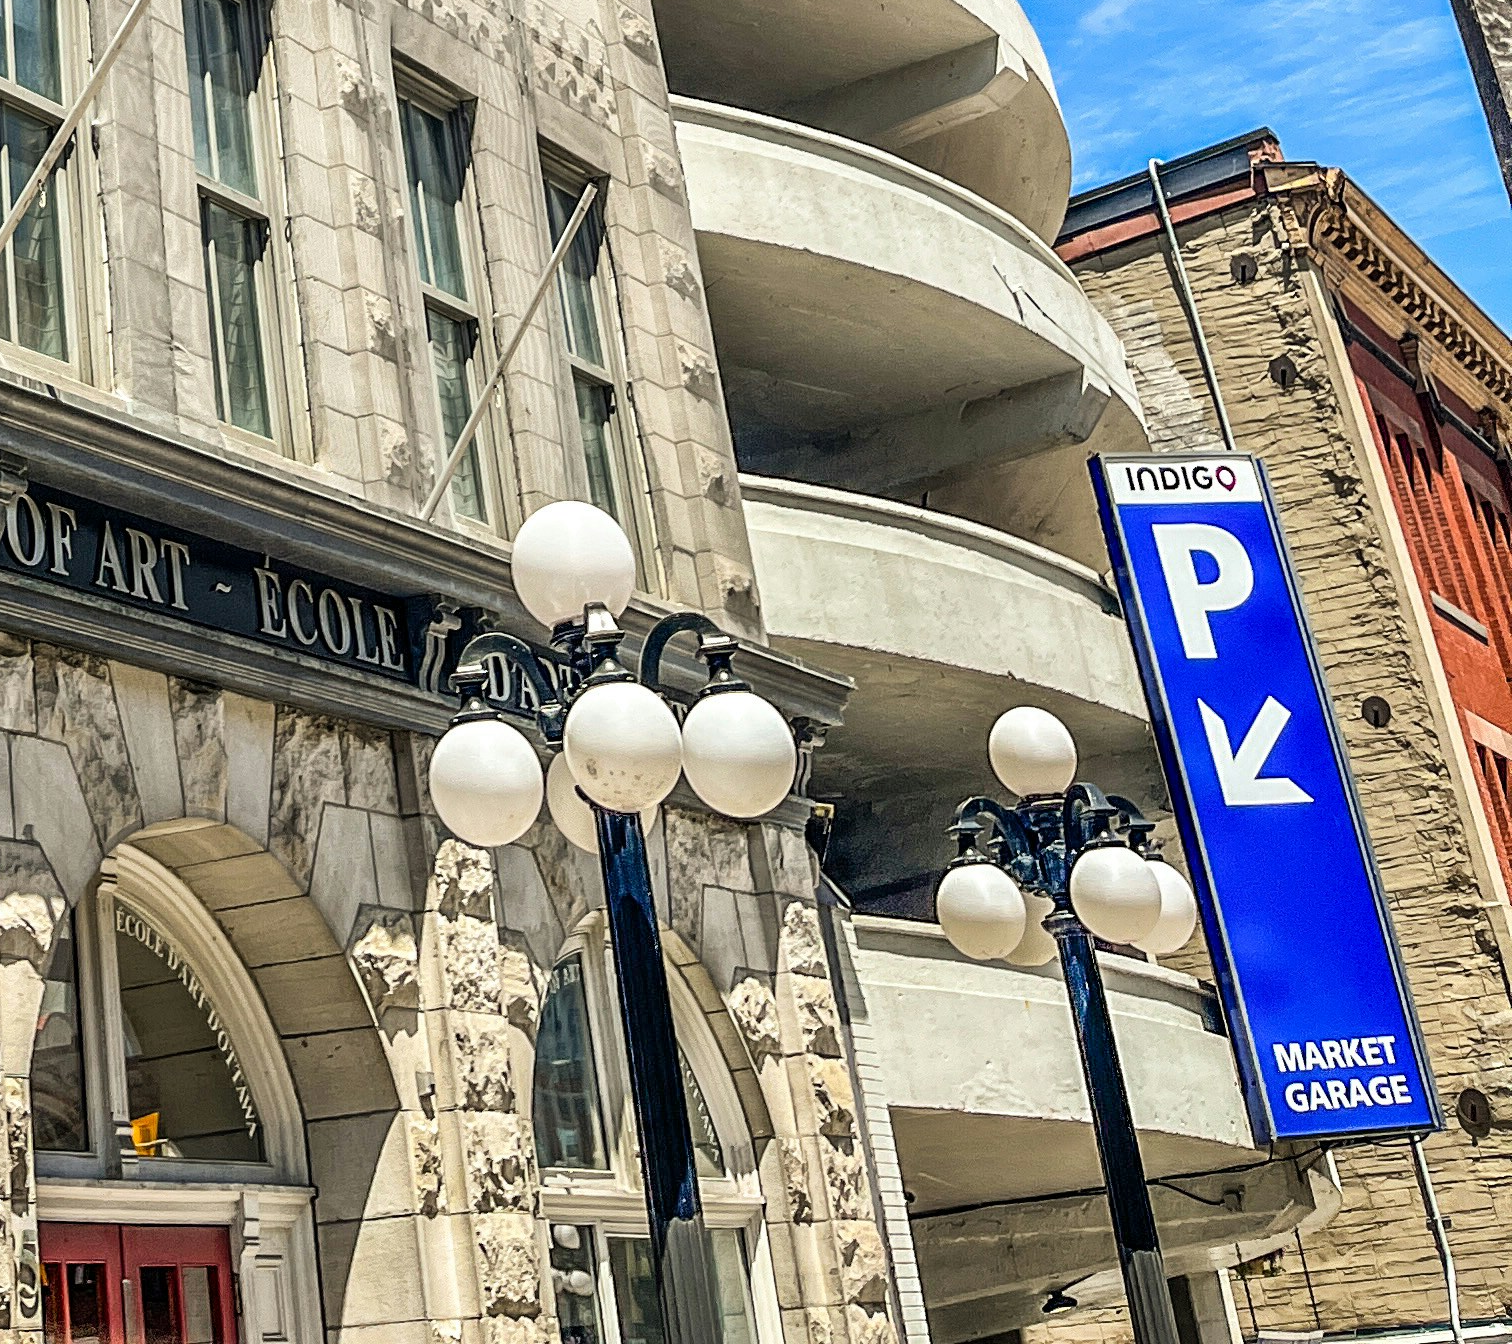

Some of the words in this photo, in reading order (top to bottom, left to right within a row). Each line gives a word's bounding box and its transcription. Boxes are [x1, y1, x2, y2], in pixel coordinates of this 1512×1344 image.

[1125, 465, 1237, 492] INDIGO
[5, 491, 78, 576] OF
[95, 520, 190, 611] ART
[253, 553, 405, 672] ÉCOLE
[1151, 522, 1255, 659] P
[1272, 1035, 1396, 1073] MARKET
[1285, 1074, 1413, 1113] GARAGE
